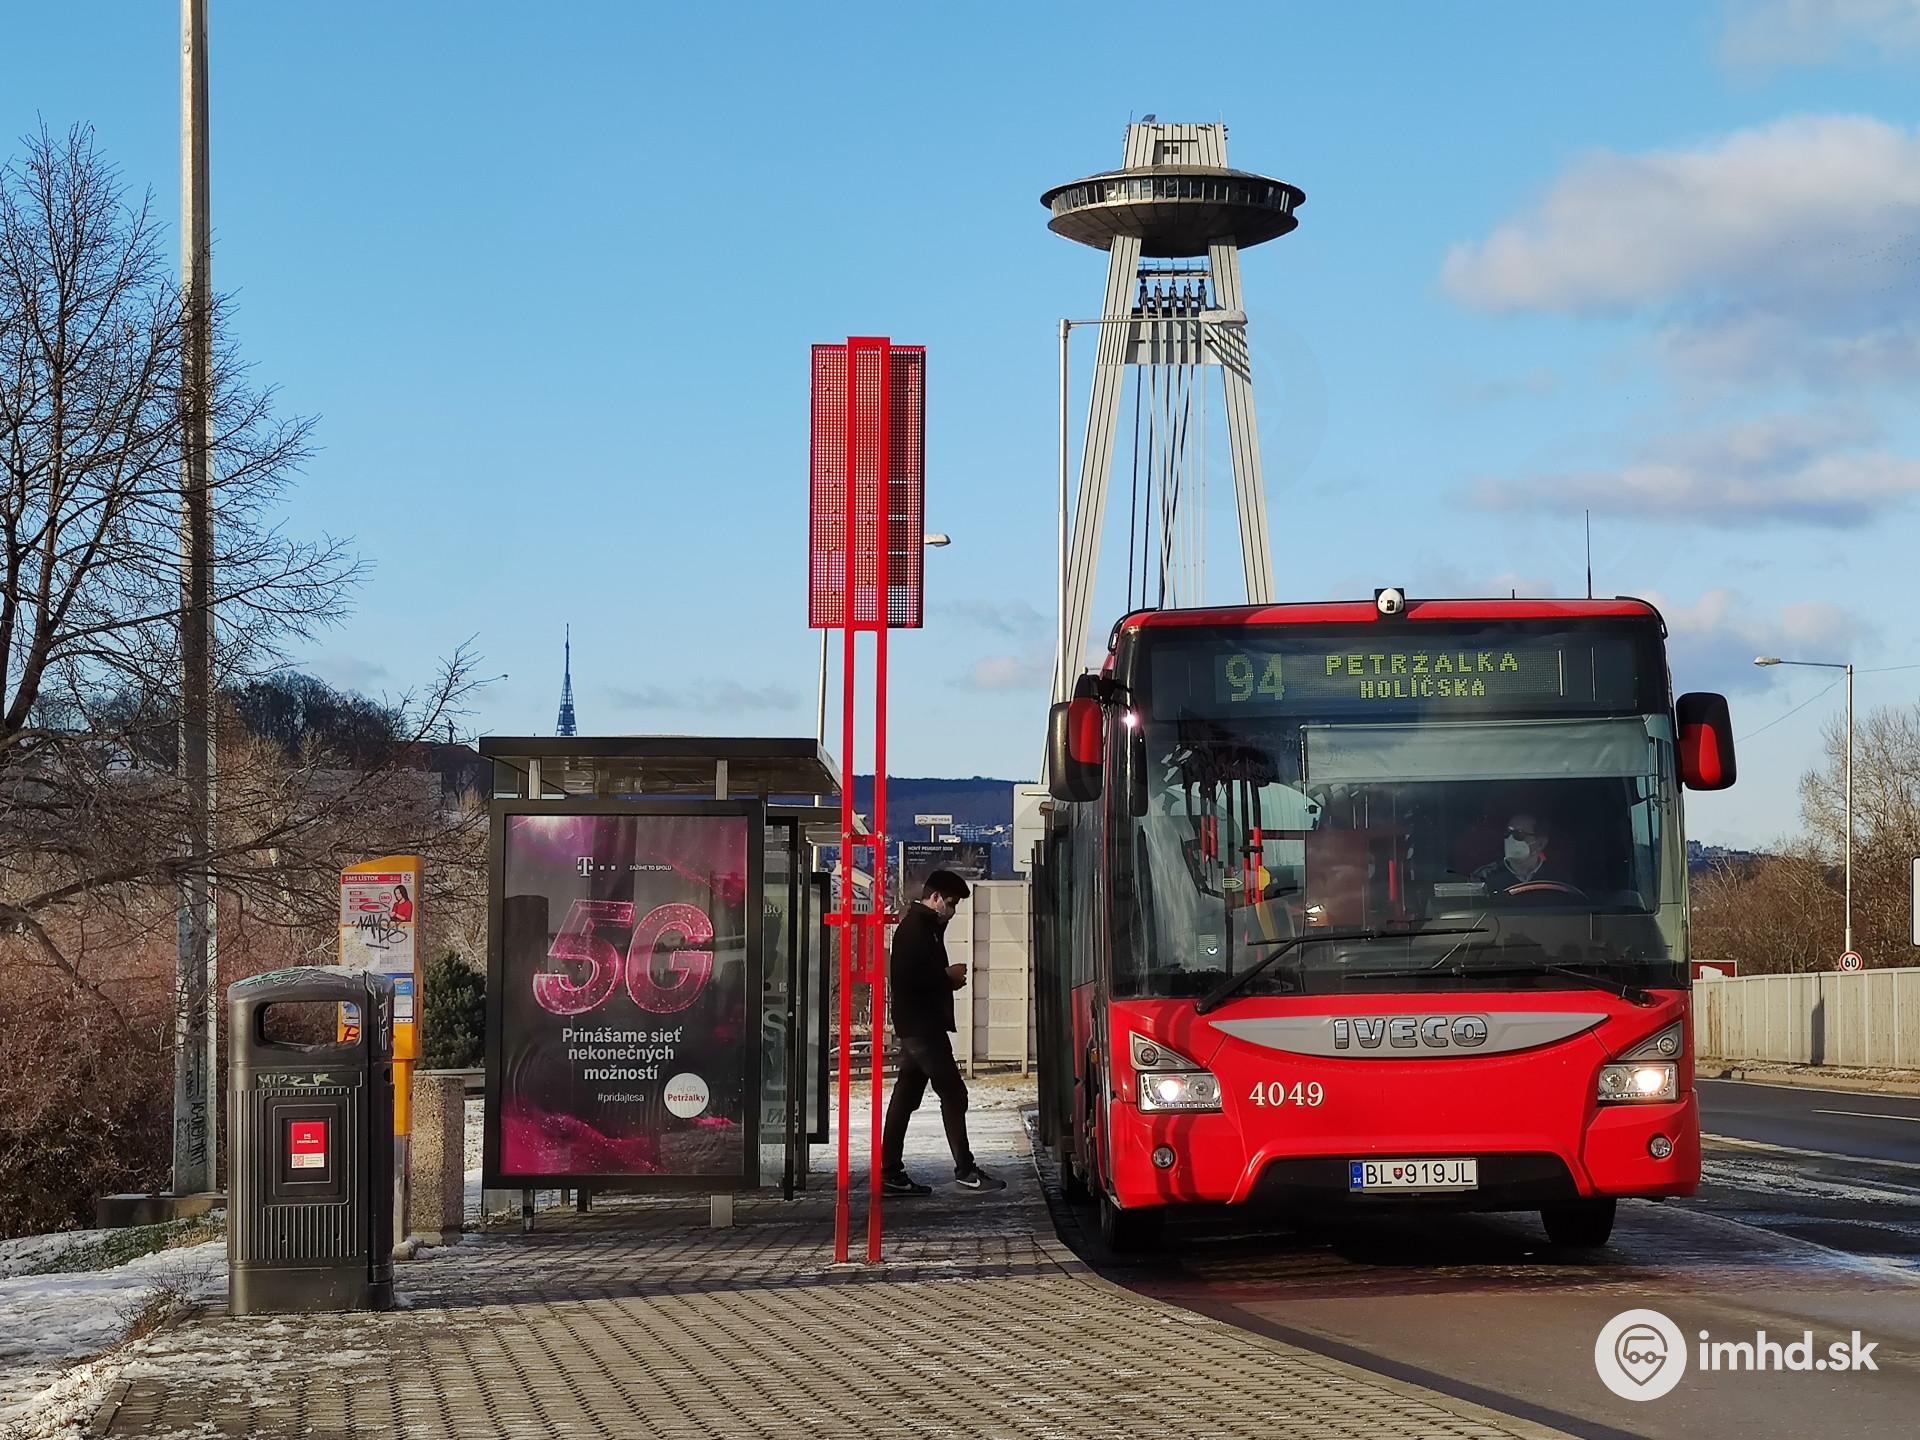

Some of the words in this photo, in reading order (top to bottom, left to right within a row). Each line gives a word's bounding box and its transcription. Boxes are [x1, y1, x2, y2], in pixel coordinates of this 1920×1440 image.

[1325, 650, 1519, 676] PETRŽALKA
[1225, 654, 1285, 701] 94
[1360, 674, 1486, 699] HOLÍČSKA
[533, 899, 714, 1015] 5G
[1845, 957, 1857, 968] 60
[562, 1027, 647, 1043] Prinášame
[650, 1026, 683, 1043] sieť
[1333, 1016, 1488, 1049] IVECO
[568, 1045, 674, 1063] nekonečných
[584, 1065, 660, 1080] možností
[597, 1092, 645, 1103] #pridajtesa
[667, 1092, 706, 1103] Petržalky
[1248, 1081, 1324, 1106] 4049
